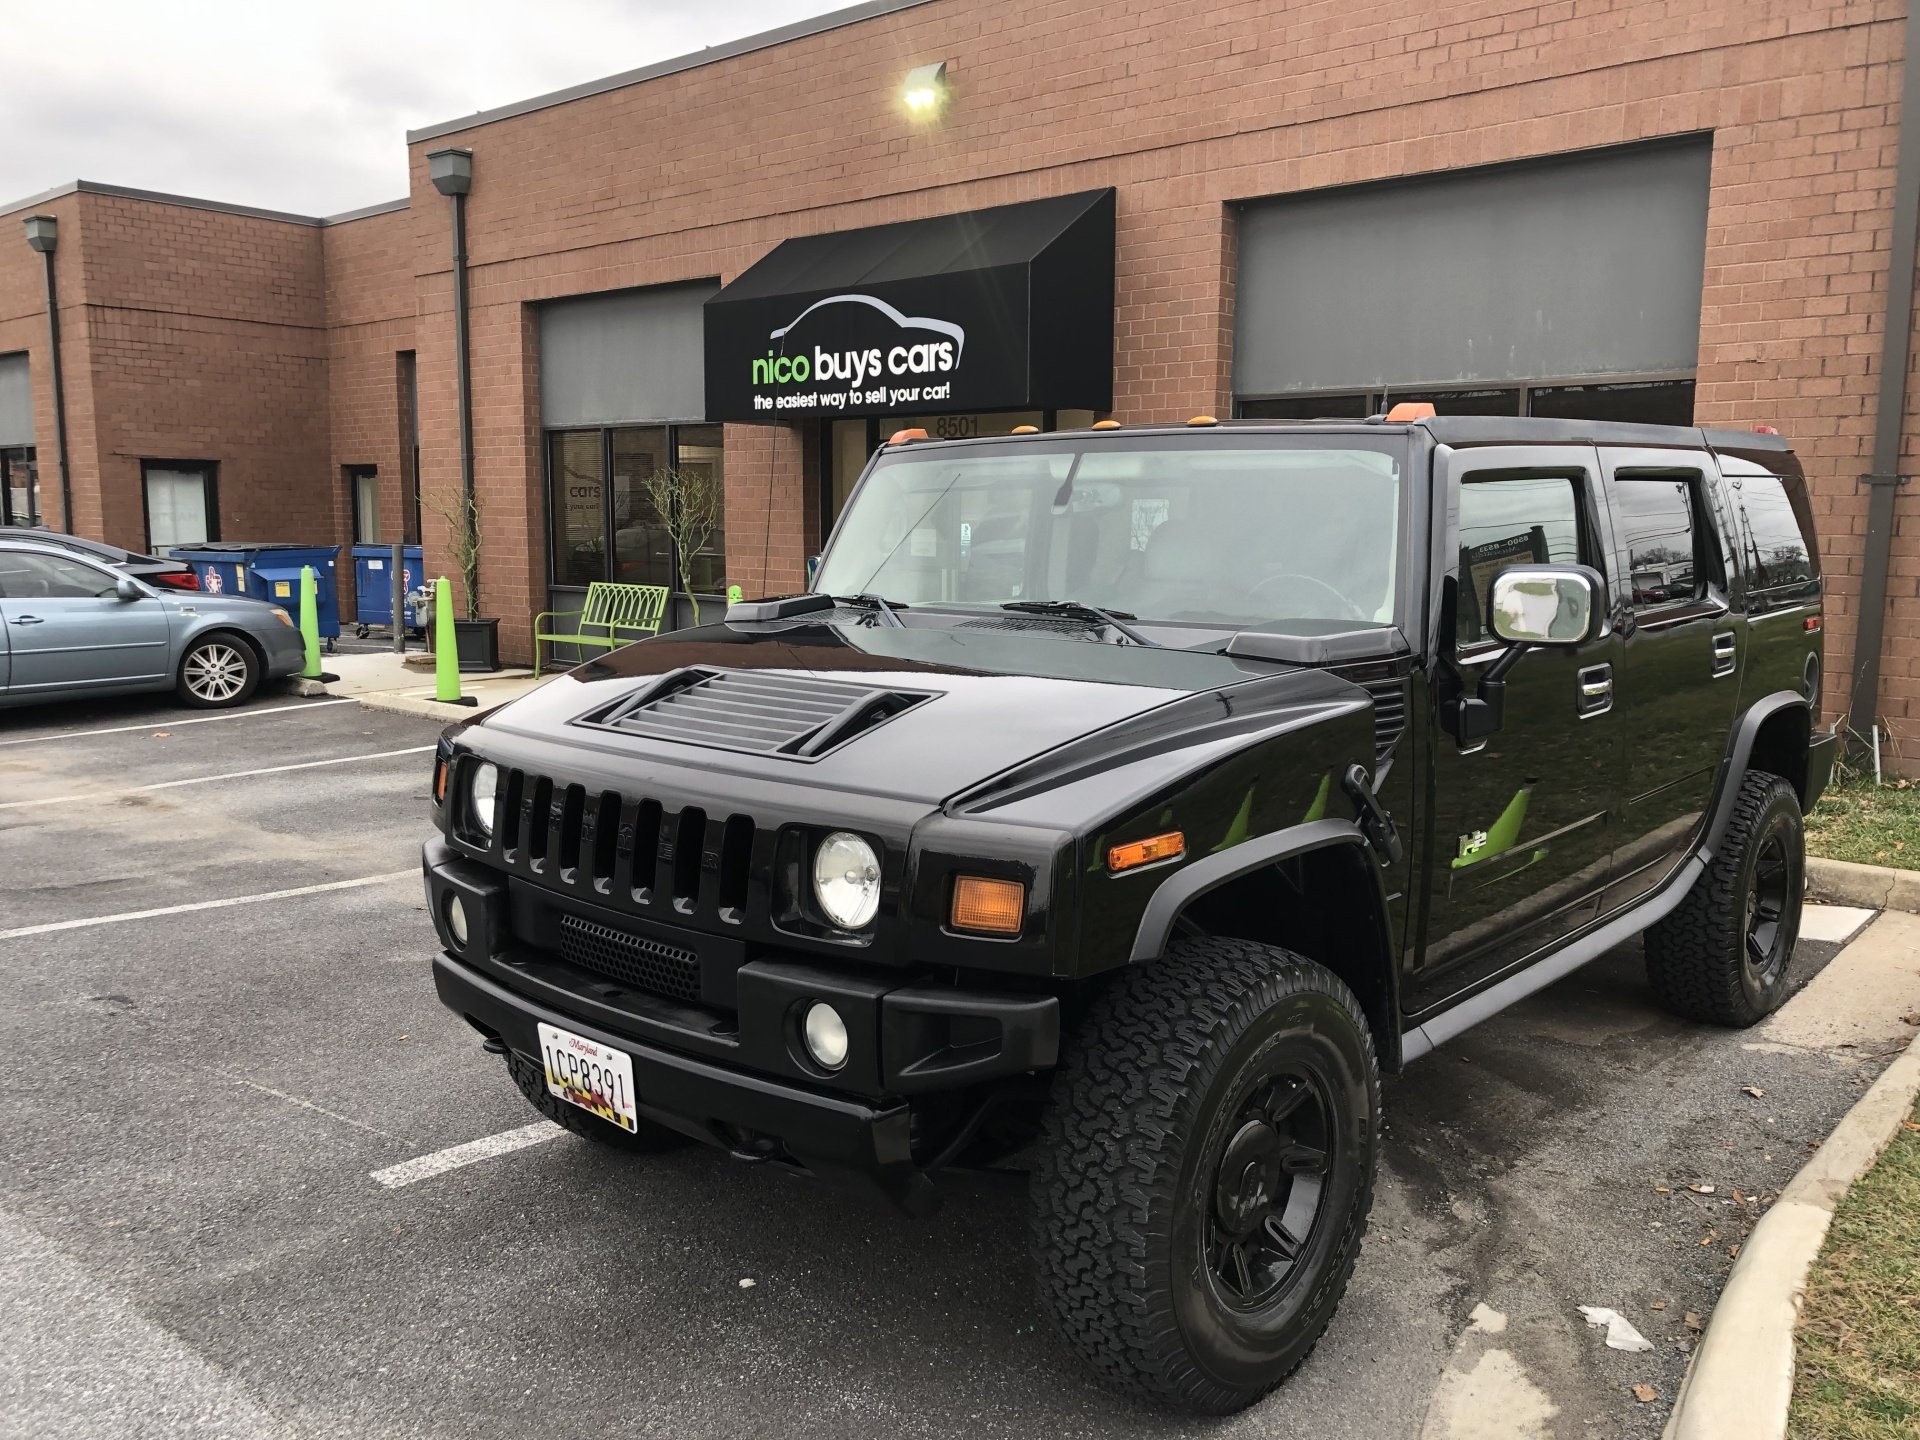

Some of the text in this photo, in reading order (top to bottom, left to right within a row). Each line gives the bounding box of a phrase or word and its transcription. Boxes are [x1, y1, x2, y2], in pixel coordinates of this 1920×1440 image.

[752, 341, 953, 388] nico buys cars
[754, 381, 951, 410] the easiest way to sell your car!
[936, 415, 978, 438] 8501
[570, 486, 601, 498] cars
[568, 1038, 598, 1057] Maryland
[546, 1045, 626, 1111] 1CP8391
